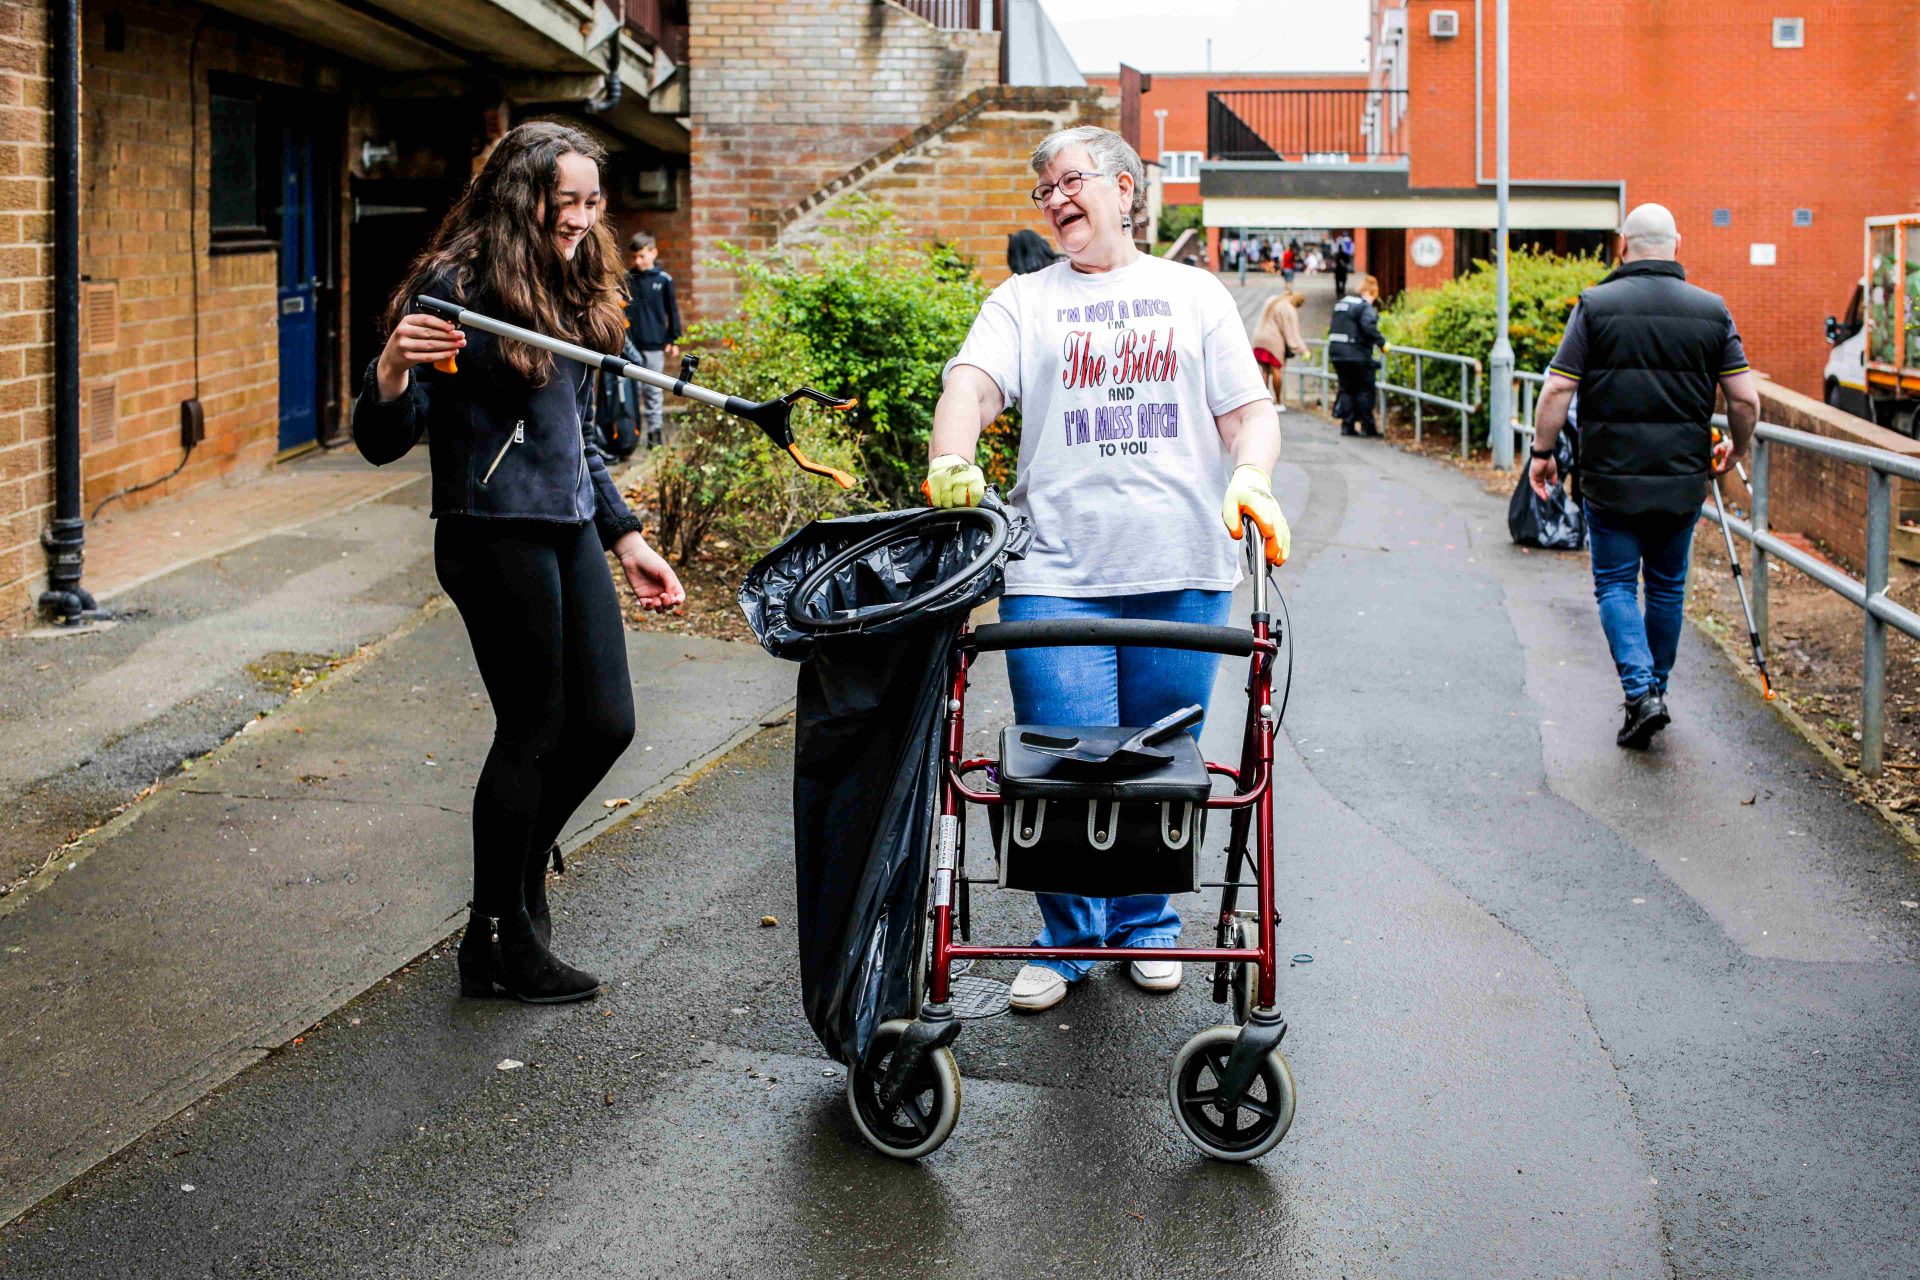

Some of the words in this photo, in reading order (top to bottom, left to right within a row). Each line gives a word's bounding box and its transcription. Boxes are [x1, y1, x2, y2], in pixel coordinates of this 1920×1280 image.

[1057, 307, 1081, 323] I'M
[1085, 301, 1115, 323] NOT
[1118, 300, 1130, 319] A
[1132, 299, 1173, 318] BITCH
[1107, 320, 1126, 330] I'M
[1063, 330, 1107, 390] The
[1112, 327, 1179, 385] Bitch
[1108, 387, 1135, 402] AND
[1064, 408, 1091, 446] I'M
[1095, 406, 1134, 442] MISS
[1137, 403, 1179, 439] BITCH
[1099, 443, 1117, 458] TO
[1120, 441, 1148, 456] YOU
